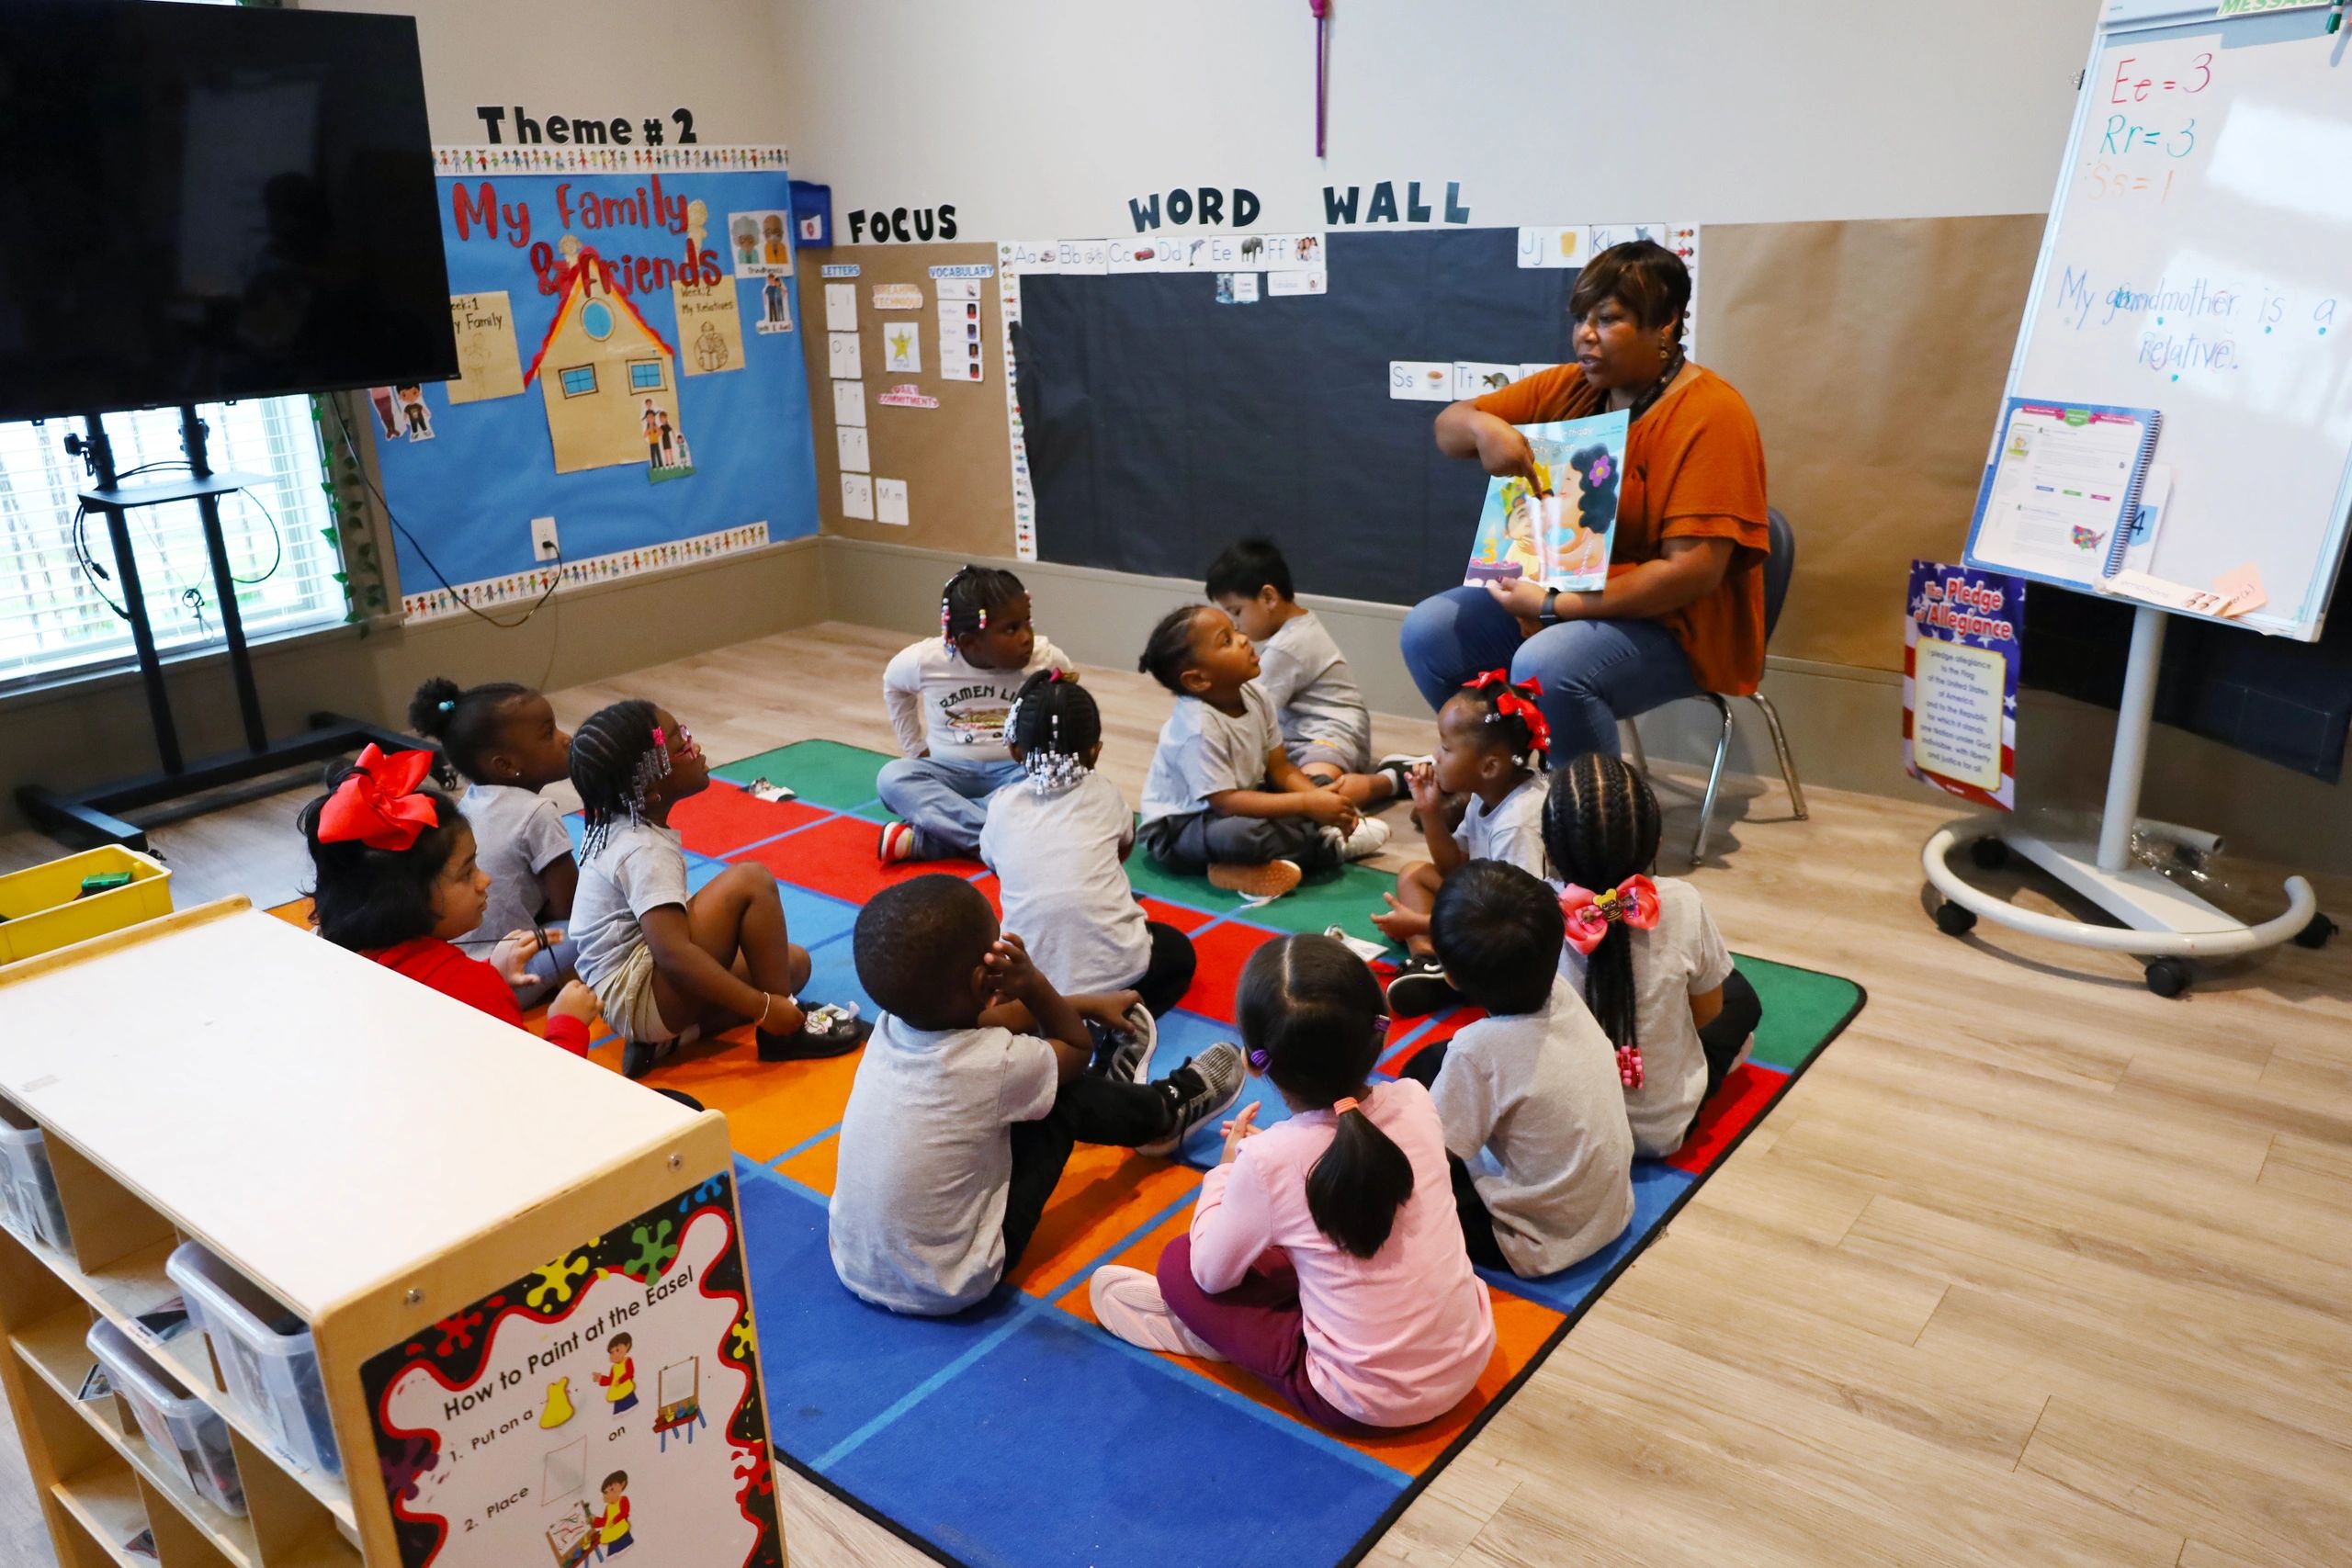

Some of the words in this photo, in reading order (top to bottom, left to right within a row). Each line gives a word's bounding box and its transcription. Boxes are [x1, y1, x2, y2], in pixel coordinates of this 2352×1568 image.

[2110, 58, 2152, 104] Ee
[2182, 53, 2212, 93] 3
[477, 106, 632, 144] Theme
[2166, 118, 2195, 158] 3
[452, 182, 530, 247] My
[1128, 187, 1261, 232] WORD
[1323, 181, 1470, 225] WALL
[847, 204, 957, 243] FOCUS
[1014, 245, 1035, 265] Aa
[1059, 244, 1081, 265] Bb
[1108, 243, 1131, 264] Cc
[1159, 241, 1182, 262] Dd
[1212, 240, 1232, 261] Ee
[1268, 239, 1287, 260] Ff
[1521, 231, 1544, 266] Jj
[822, 265, 860, 276] LETTERS
[930, 265, 994, 277] VOCABULARY
[450, 297, 480, 310] eek:1
[2057, 265, 2096, 330] My
[2258, 286, 2286, 323] is
[2312, 299, 2337, 323] a
[466, 311, 503, 331] Family
[1392, 366, 1413, 388] Ss
[1456, 366, 1474, 388] Tt
[2130, 510, 2146, 536] 4
[1947, 578, 2003, 615] Pledge
[1927, 603, 2012, 639] Allegiance
[1955, 655, 1992, 670] allegiance
[939, 685, 995, 708] RAMEN
[1000, 688, 1017, 703] LI
[1947, 681, 1967, 691] United
[444, 1382, 494, 1421] How
[500, 1368, 521, 1390] to
[527, 1332, 580, 1376] Paint
[585, 1317, 605, 1342] at
[609, 1300, 641, 1329] the
[646, 1265, 695, 1307] Easel
[450, 1450, 464, 1462] 1.
[471, 1428, 496, 1450] Put
[500, 1418, 519, 1435] on
[523, 1409, 534, 1420] a
[464, 1518, 479, 1532] 2.
[486, 1486, 529, 1518] Place
[608, 1426, 627, 1442] on
